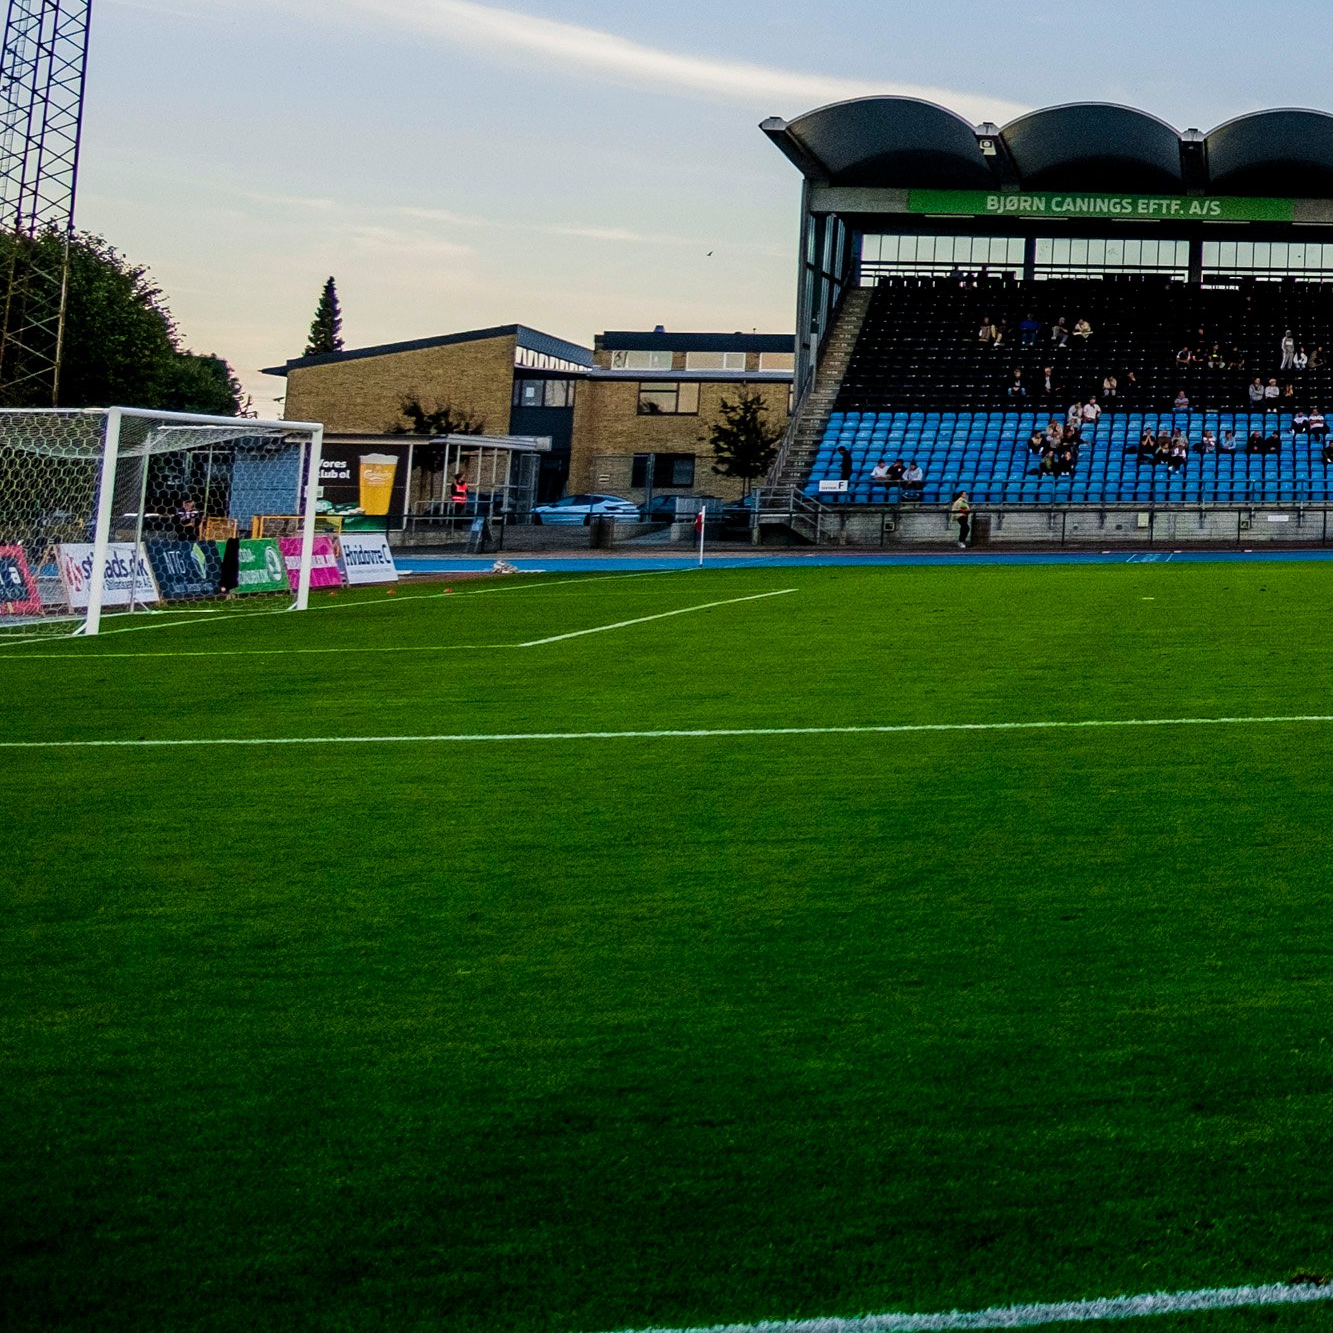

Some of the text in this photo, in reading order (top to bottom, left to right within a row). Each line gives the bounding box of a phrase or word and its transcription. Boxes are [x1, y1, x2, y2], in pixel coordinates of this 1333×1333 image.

[986, 195, 1221, 215] BJØRN CANINGS EFTF. A/S
[318, 468, 338, 479] lub
[838, 481, 845, 490] F
[163, 551, 187, 574] NTG
[342, 544, 385, 566] Hvidovre
[381, 543, 392, 564] C
